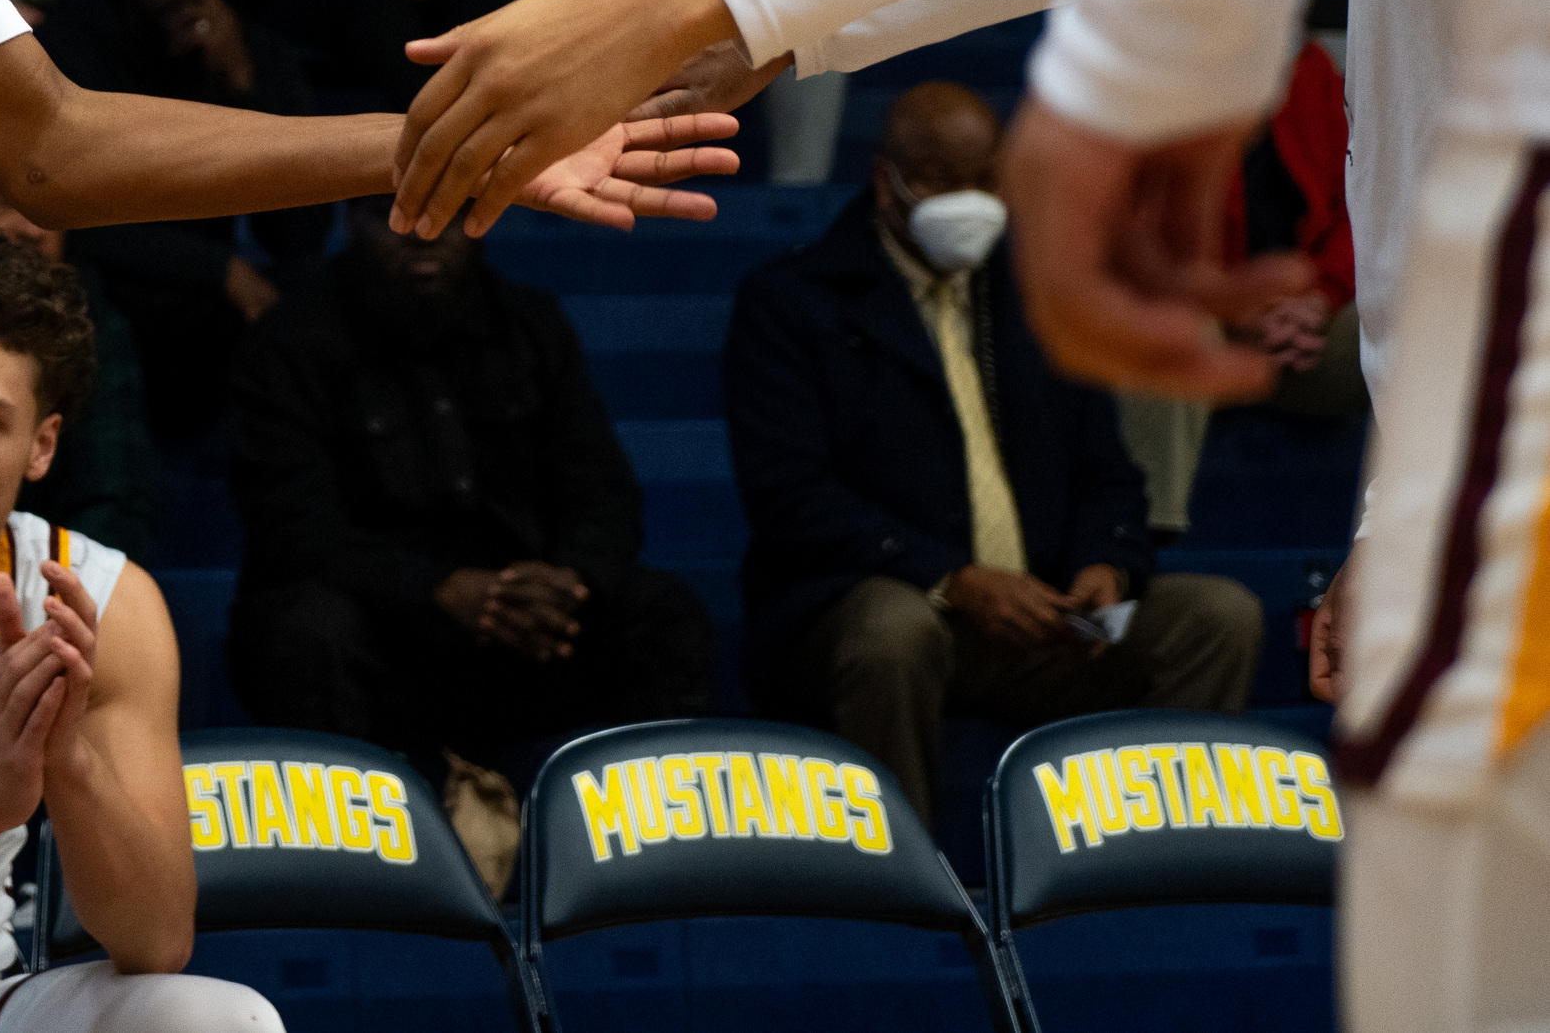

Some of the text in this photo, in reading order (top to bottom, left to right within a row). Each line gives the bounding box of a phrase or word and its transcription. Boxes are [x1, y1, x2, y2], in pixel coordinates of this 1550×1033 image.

[183, 760, 419, 866] STANGS
[571, 751, 894, 863] MUSTANGS
[1033, 742, 1345, 855] MUSTANGS
